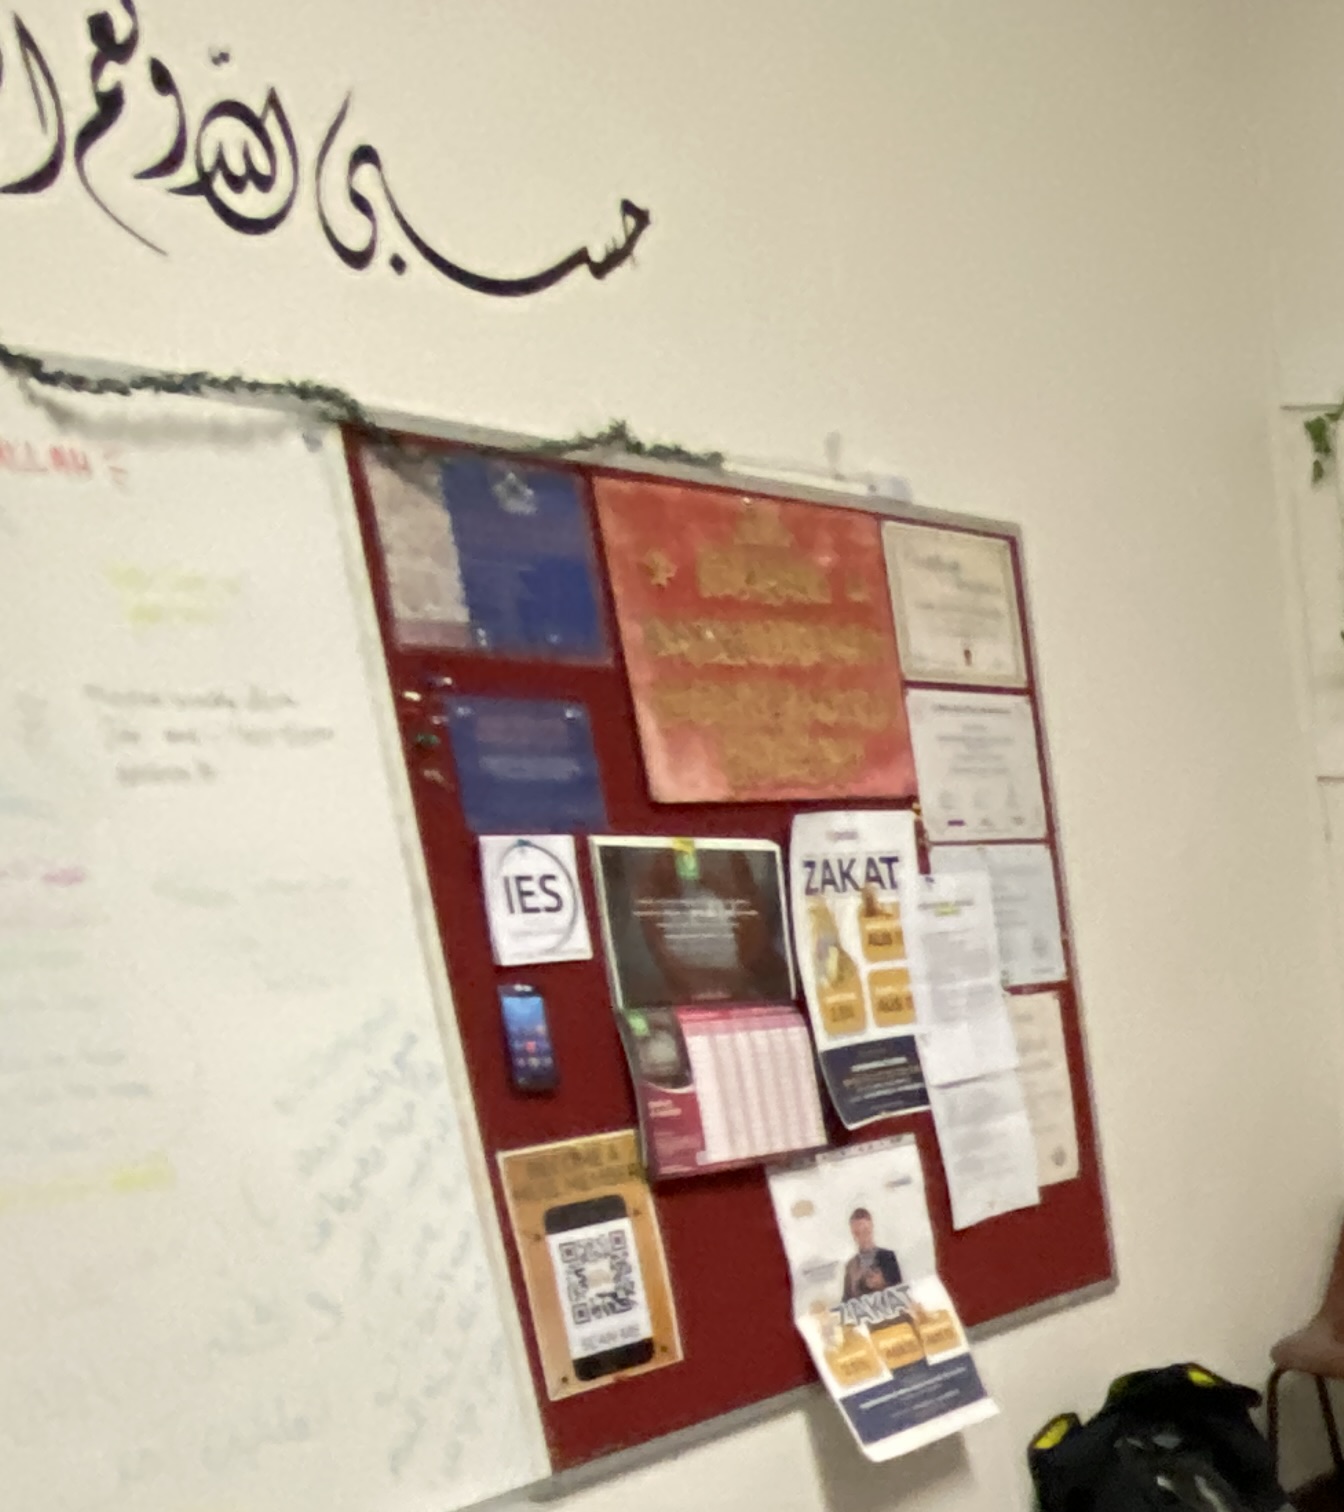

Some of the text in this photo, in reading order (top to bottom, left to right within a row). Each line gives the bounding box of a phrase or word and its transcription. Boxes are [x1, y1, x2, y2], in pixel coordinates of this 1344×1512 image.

[503, 874, 563, 914] IES
[802, 856, 900, 896] ZAKAT
[830, 1284, 914, 1327] ZAKAT
